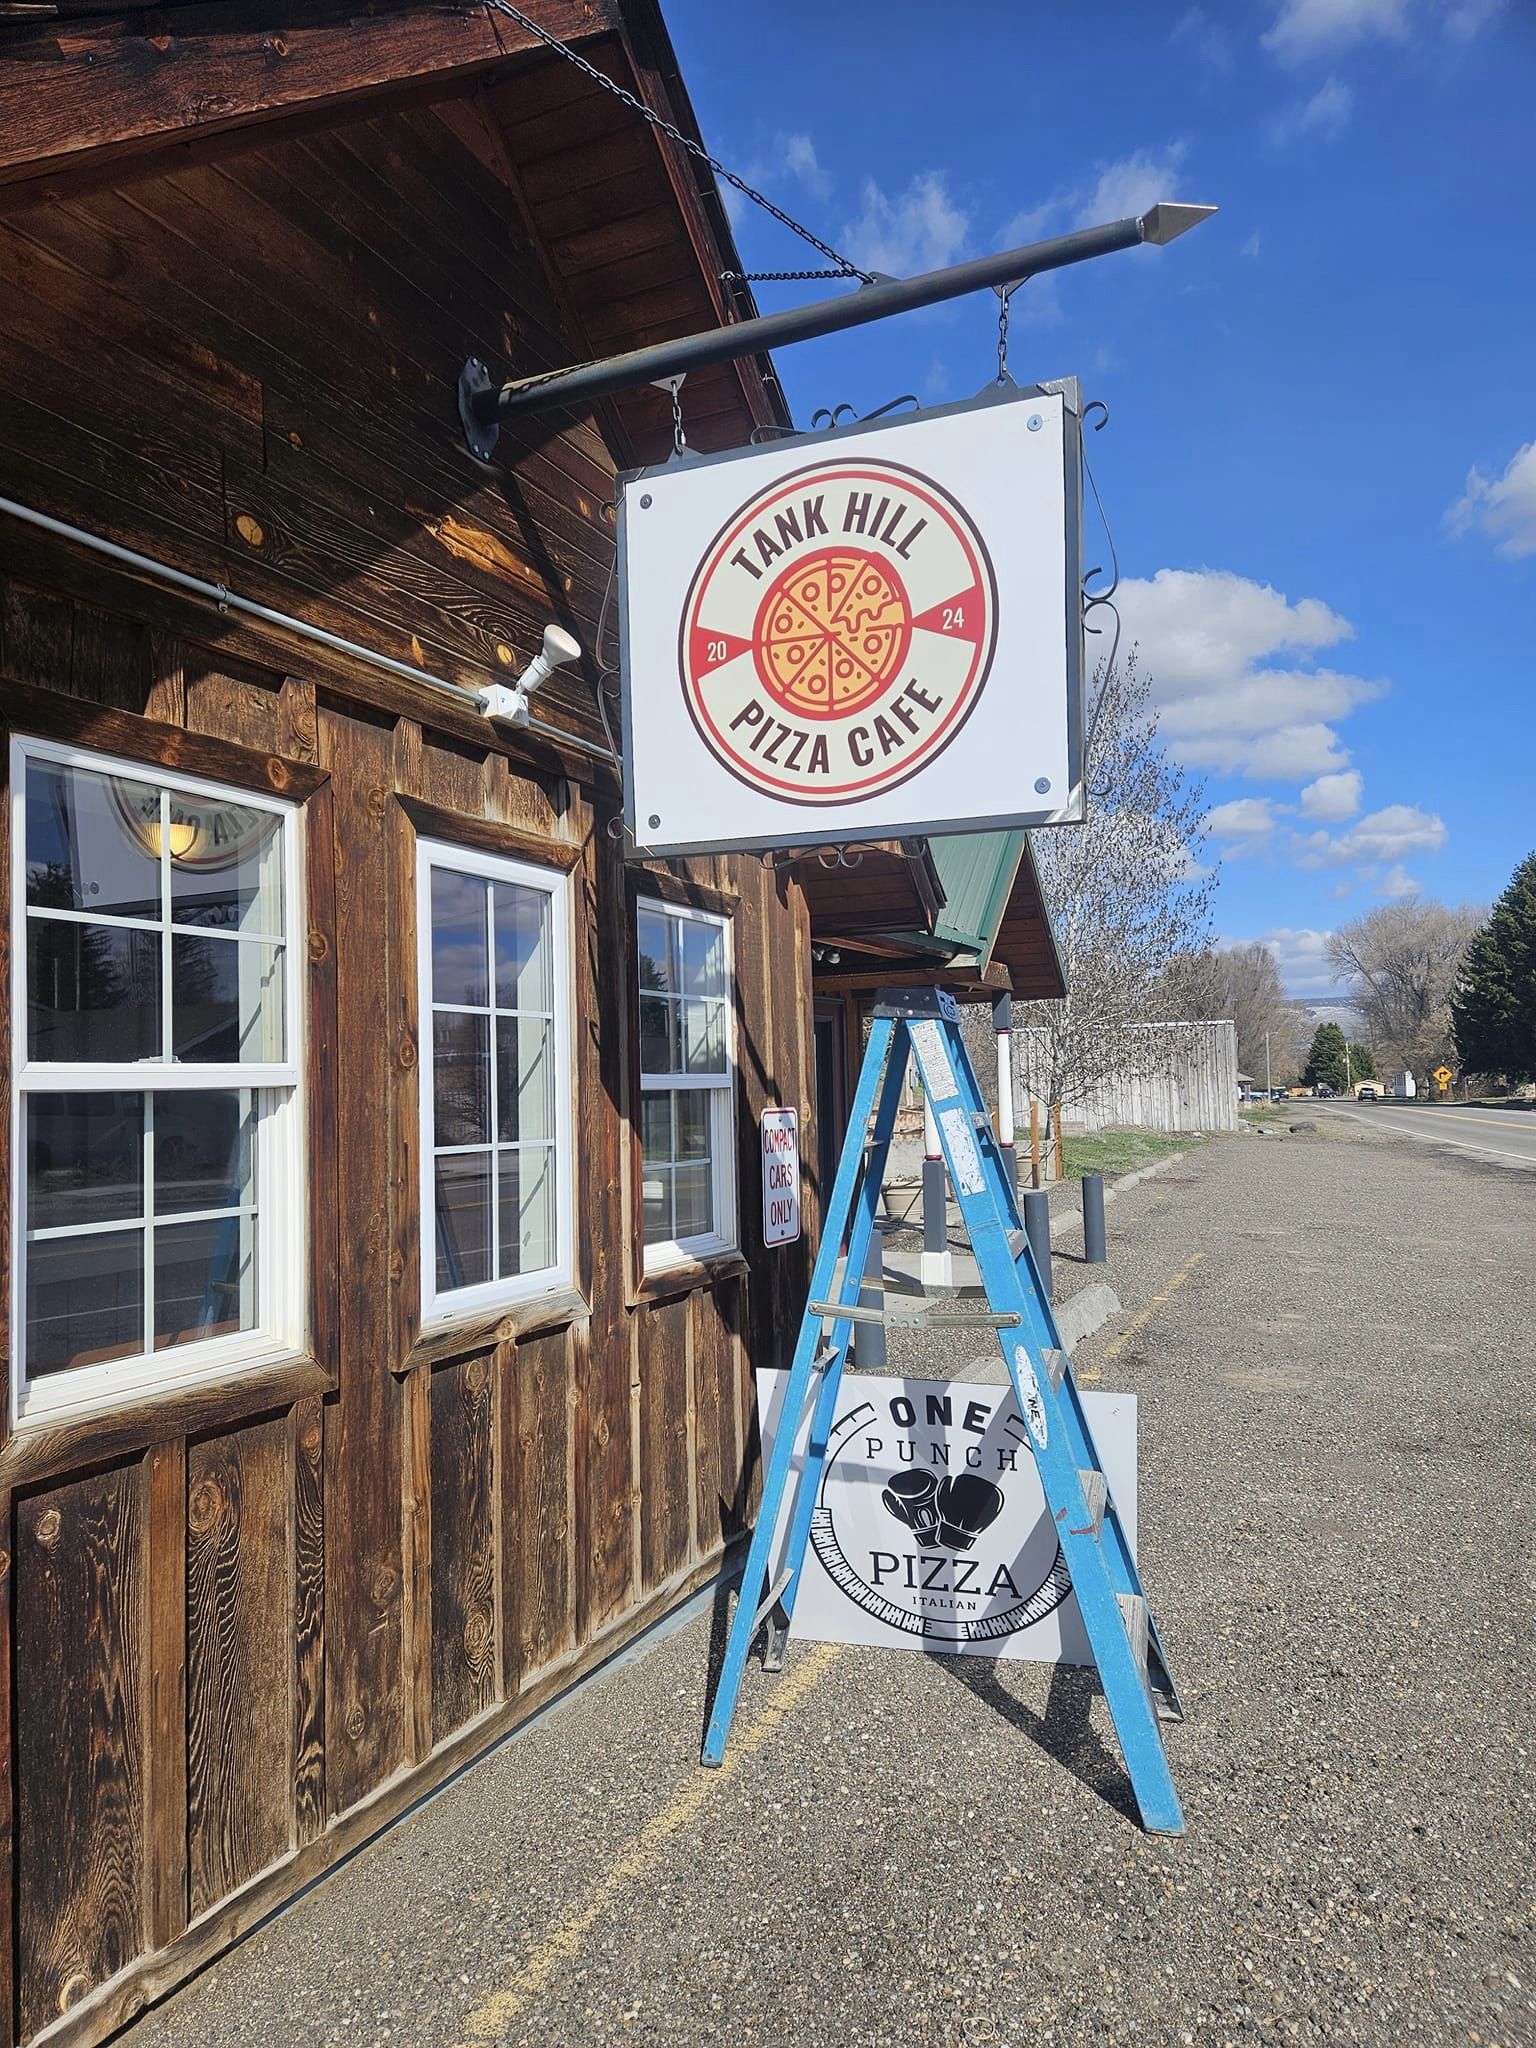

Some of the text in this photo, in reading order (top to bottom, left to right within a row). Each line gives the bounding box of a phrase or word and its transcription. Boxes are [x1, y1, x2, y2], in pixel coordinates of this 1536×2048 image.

[730, 492, 928, 580] TANK HILL
[707, 607, 965, 662] 20 24
[729, 677, 944, 774] PIZZA CAFE
[764, 1127, 795, 1154] COMPACT
[769, 1163, 793, 1190] CARS
[770, 1198, 793, 1227] ONLY
[889, 1394, 992, 1434] ONE
[865, 1437, 1018, 1472] PUNCH
[868, 1551, 1023, 1599] PIZZA
[912, 1596, 977, 1611] ITALIAN
